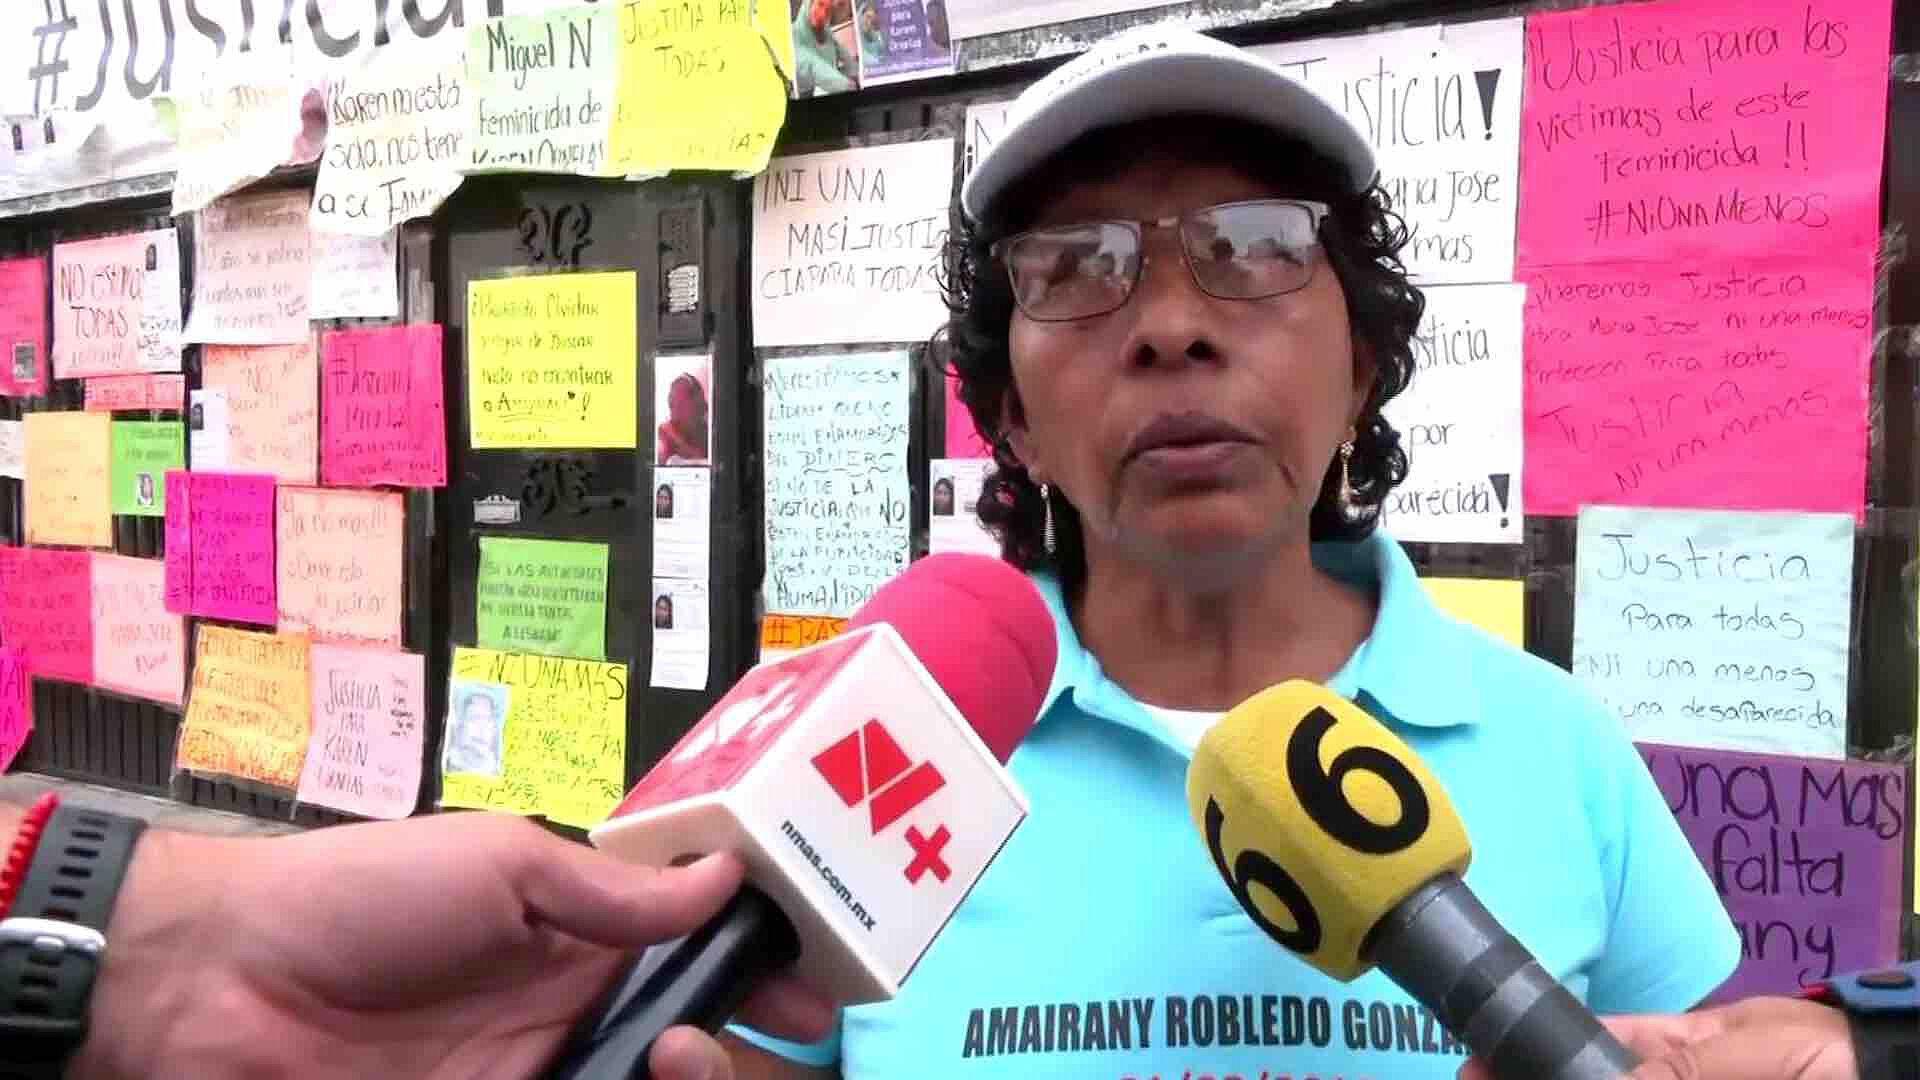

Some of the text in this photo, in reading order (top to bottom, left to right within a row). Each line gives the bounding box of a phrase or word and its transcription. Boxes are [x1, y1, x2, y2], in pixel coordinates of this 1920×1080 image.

[488, 18, 593, 90] Miguel N
[1698, 27, 1780, 74] para
[1803, 5, 1849, 58] las
[1676, 87, 1713, 122] de
[818, 166, 886, 203] UNA
[1408, 423, 1454, 465] por
[1597, 533, 1811, 582] Justicia
[1712, 601, 1805, 640] todas
[1714, 659, 1816, 692] menos
[1286, 705, 1431, 855] 6
[779, 818, 878, 932] nmas.com.mx
[1204, 793, 1322, 955] 6
[1712, 823, 1844, 897] falta
[962, 997, 1154, 1058] AMAIRANY
[1164, 993, 1332, 1048] ROBLEDO
